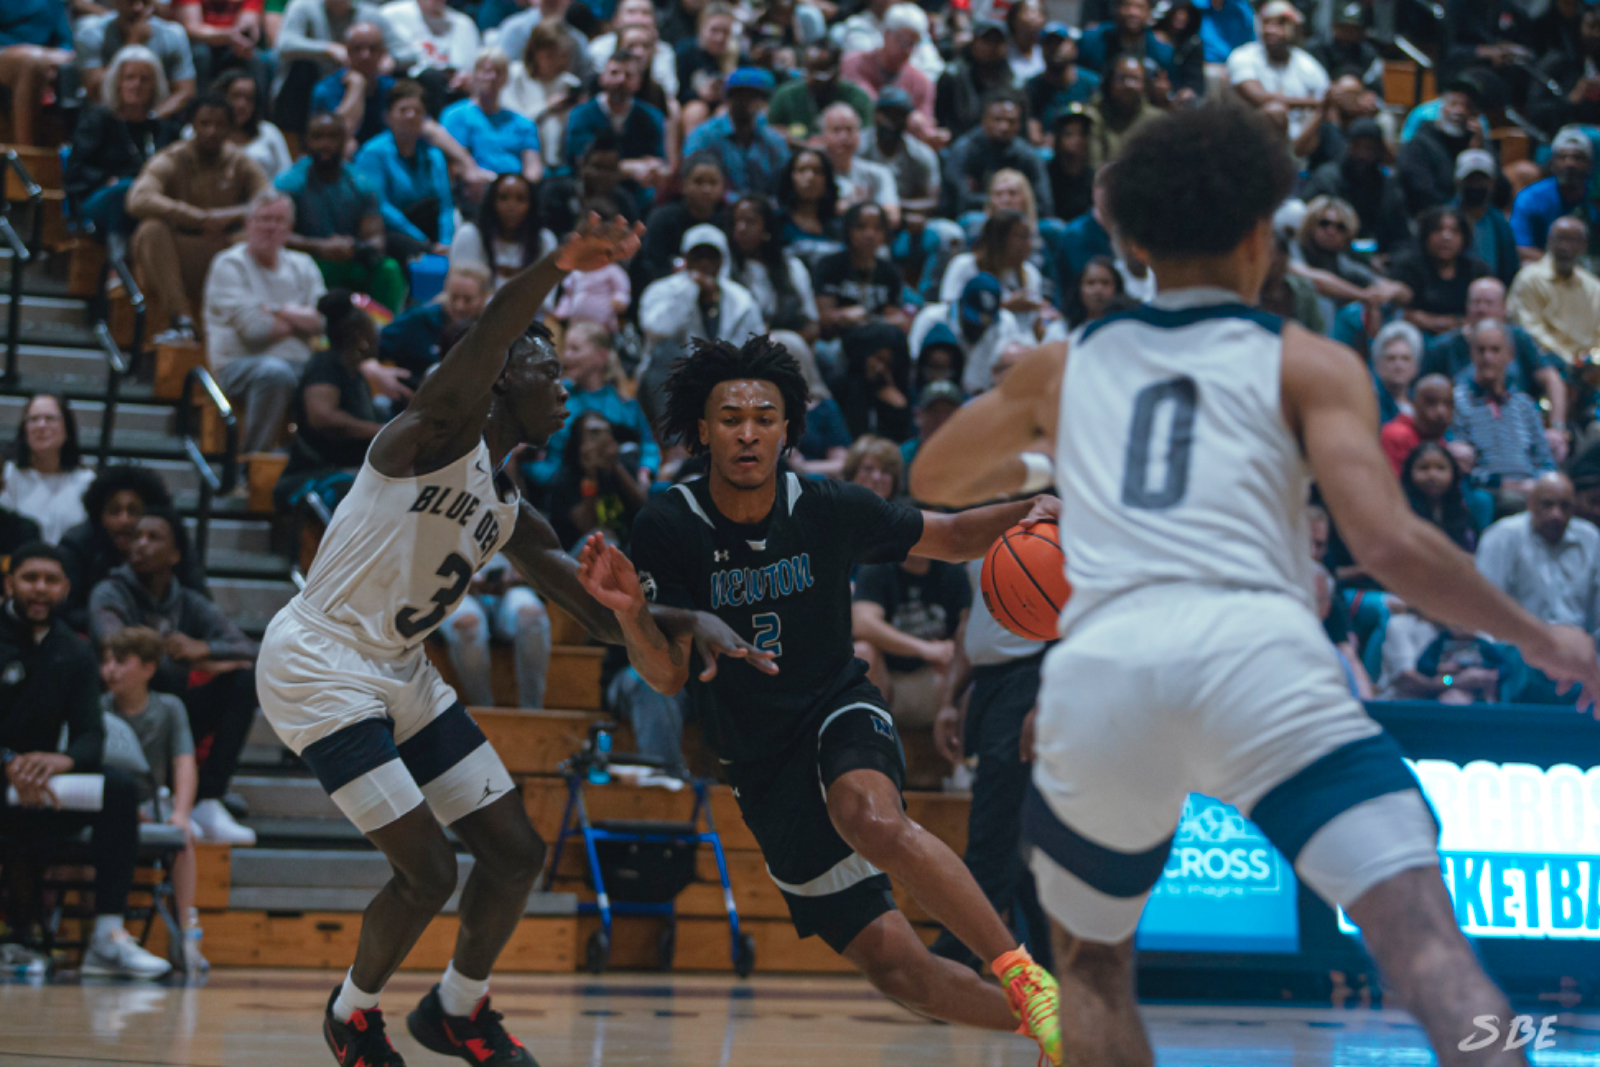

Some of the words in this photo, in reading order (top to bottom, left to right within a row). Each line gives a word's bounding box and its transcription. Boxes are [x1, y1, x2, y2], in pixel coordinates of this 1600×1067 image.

[1121, 373, 1198, 511] 0
[408, 486, 481, 527] BLUE
[395, 553, 472, 638] 3
[711, 553, 814, 609] NEWTON
[752, 612, 783, 656] 2
[1445, 857, 1600, 930] KETB
